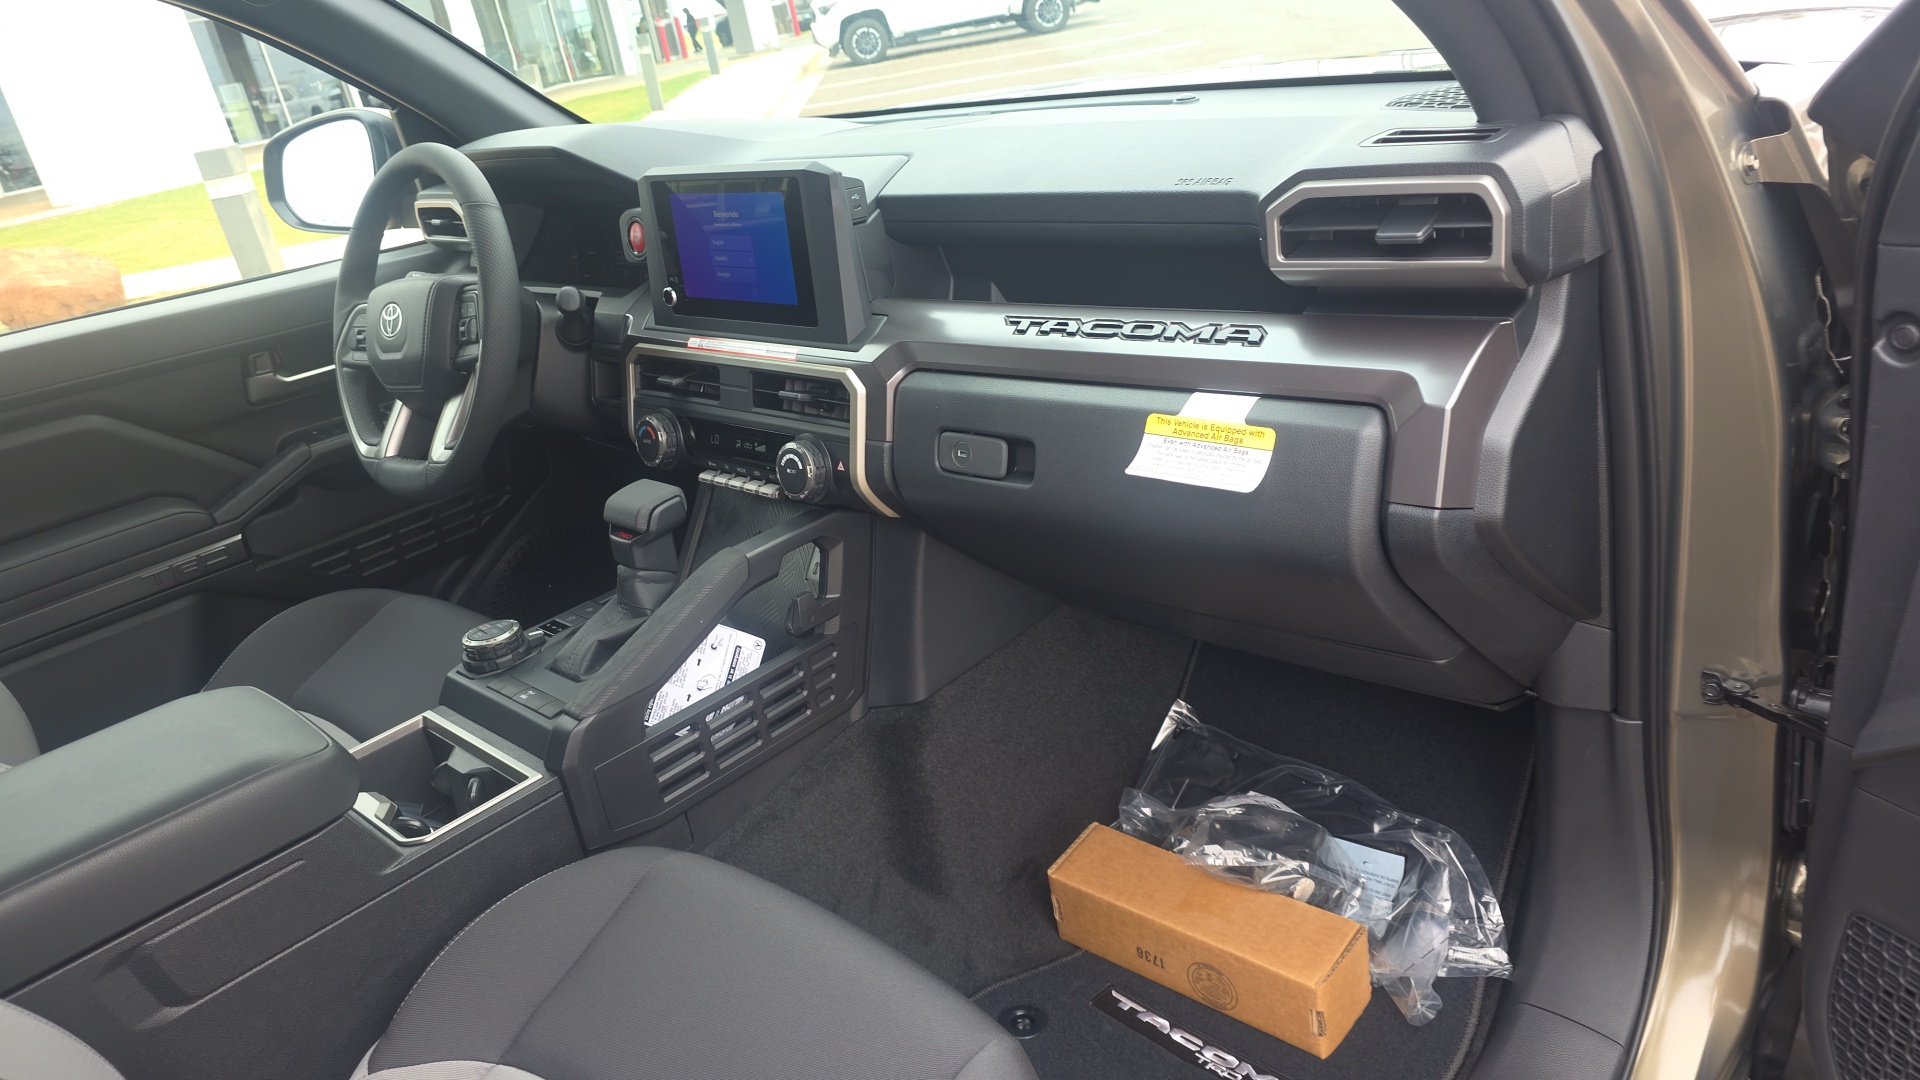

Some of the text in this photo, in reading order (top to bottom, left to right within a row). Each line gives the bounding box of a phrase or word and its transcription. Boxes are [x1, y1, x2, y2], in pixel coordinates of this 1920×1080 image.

[1003, 315, 1268, 348] TACOMA
[1156, 416, 1266, 439] This Vehicle is Equipped with
[1172, 428, 1244, 446] Advanced Air Bags
[1163, 437, 1178, 445] Even
[1192, 442, 1222, 452] Advanced
[1233, 447, 1249, 456] Bags
[140, 546, 230, 586] TRD
[1136, 946, 1165, 969] 1736
